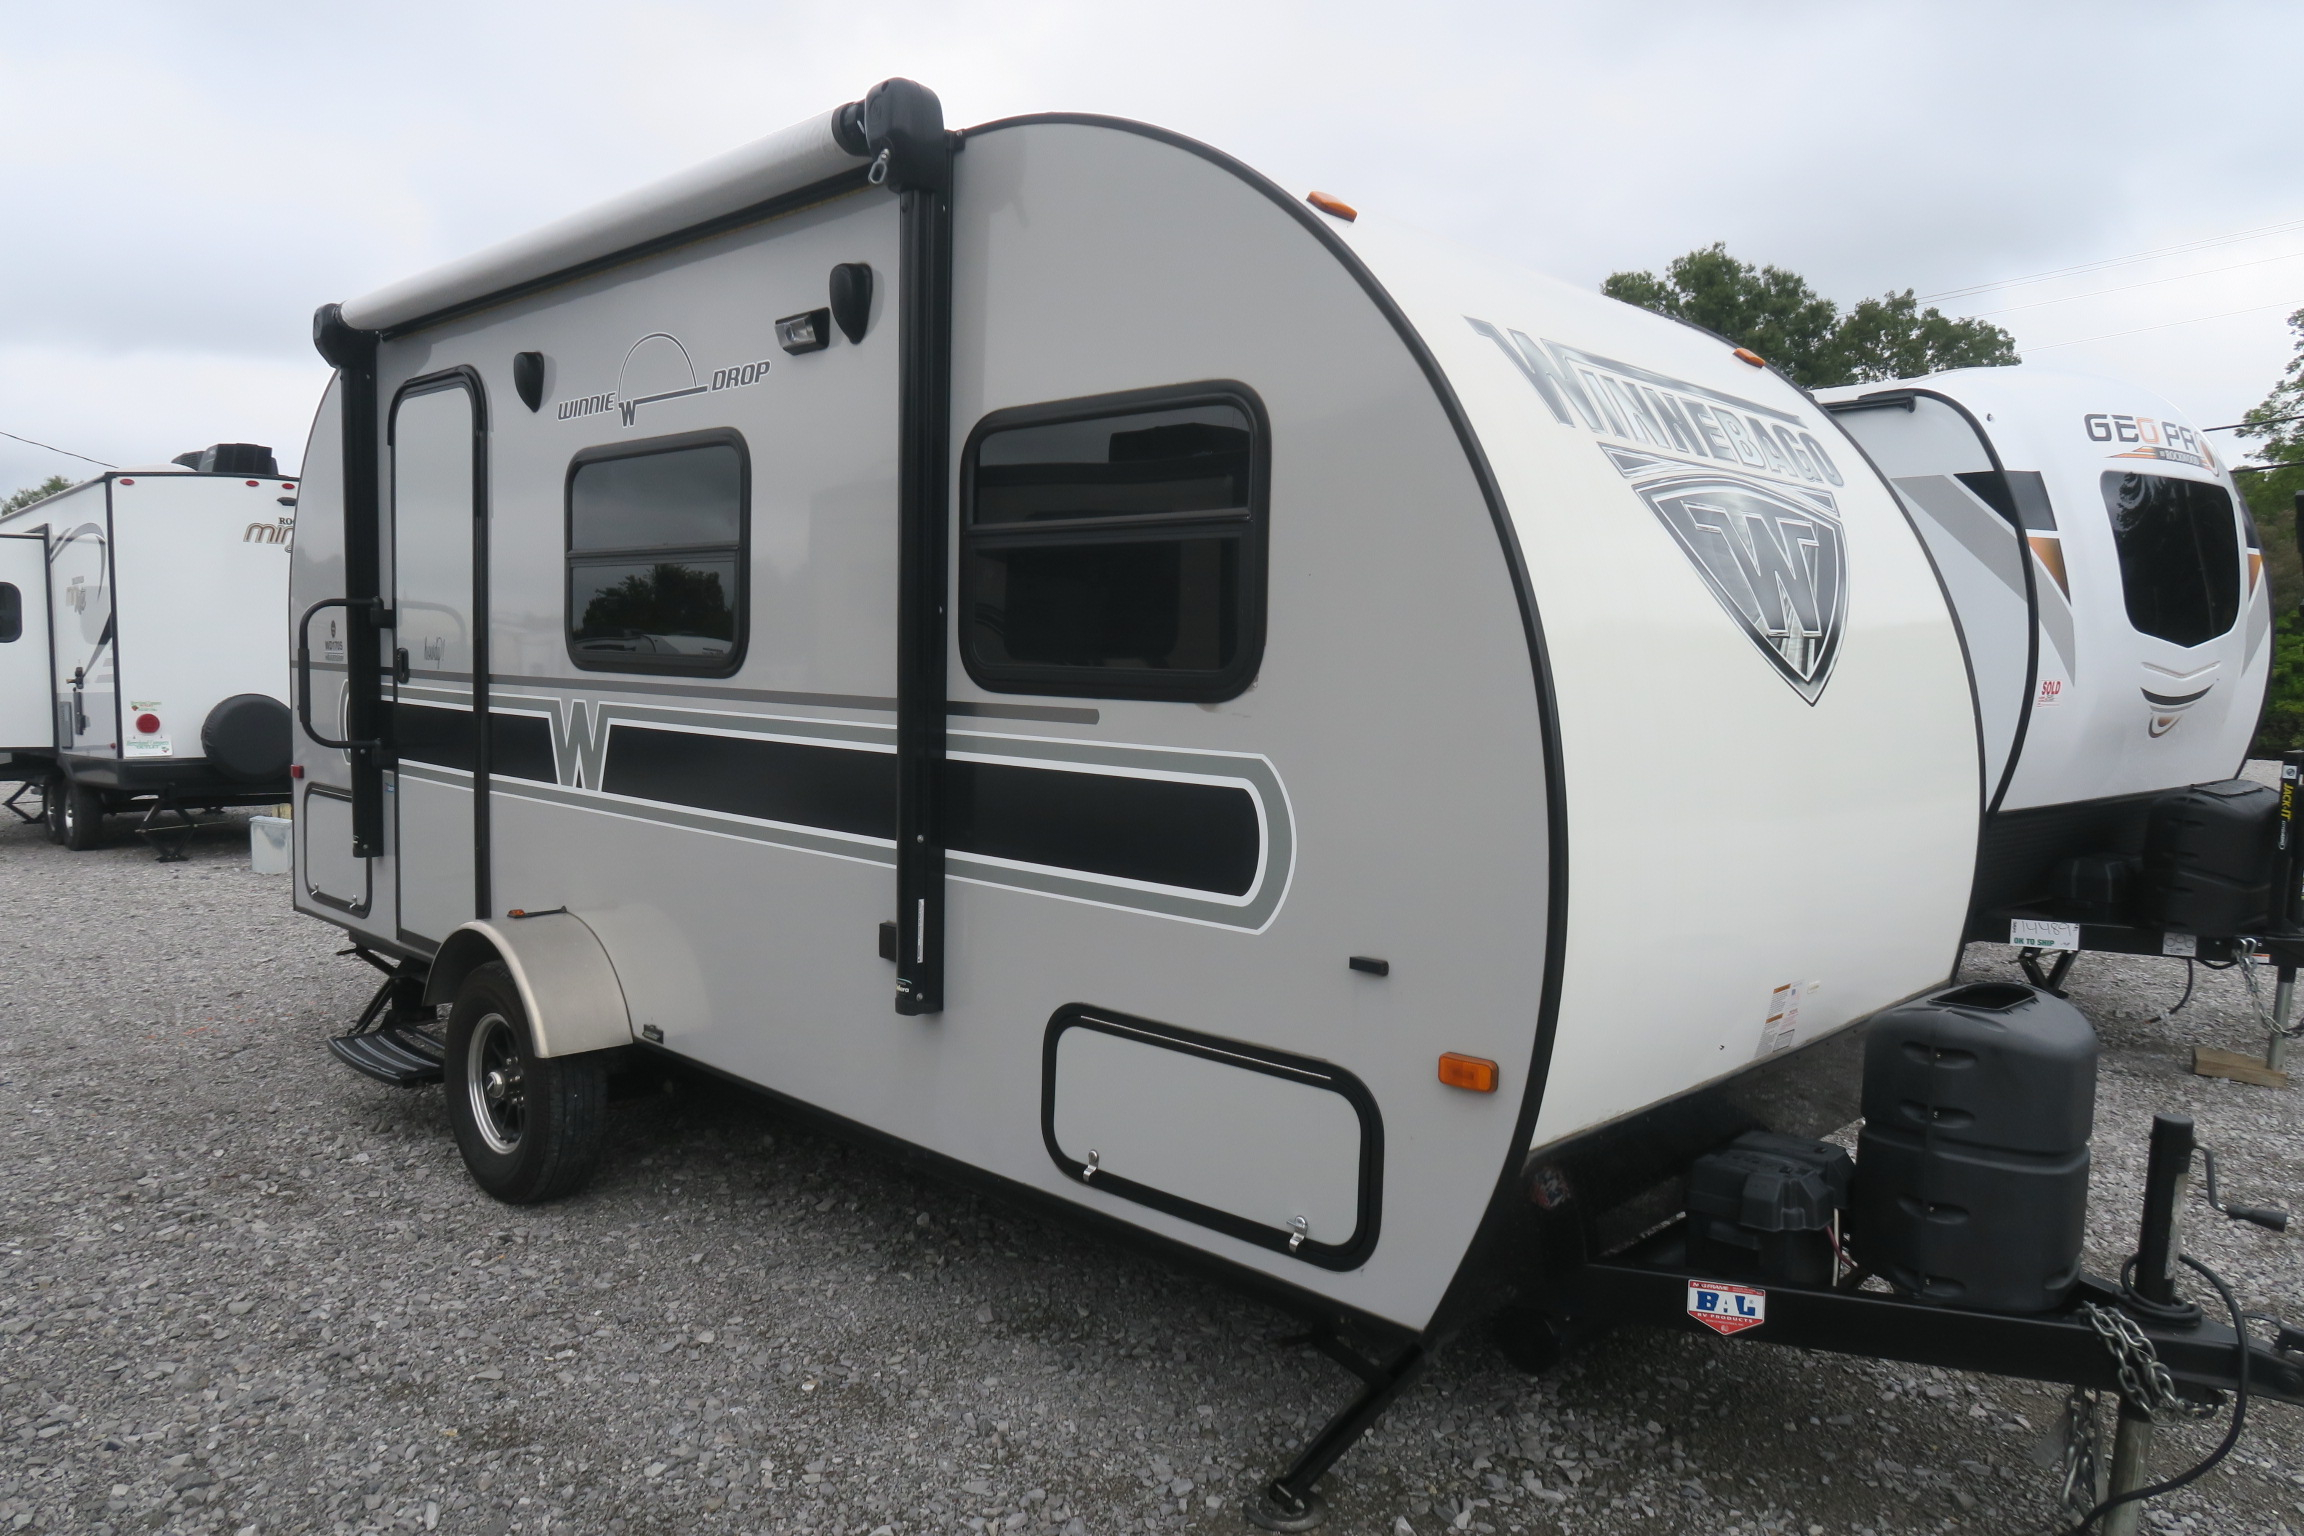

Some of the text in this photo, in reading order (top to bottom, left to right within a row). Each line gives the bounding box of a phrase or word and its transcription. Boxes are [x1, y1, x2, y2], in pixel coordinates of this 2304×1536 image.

[557, 391, 617, 421] WINNIE
[711, 360, 771, 392] DROP
[1462, 314, 1844, 488] WINNEBAGO
[2084, 413, 2219, 477] GEO PRO
[2041, 680, 2061, 695] SOLD
[2013, 937, 2024, 945] OK
[1696, 1290, 1756, 1317] BAL
[1710, 1314, 1753, 1323] PRODUCTS
